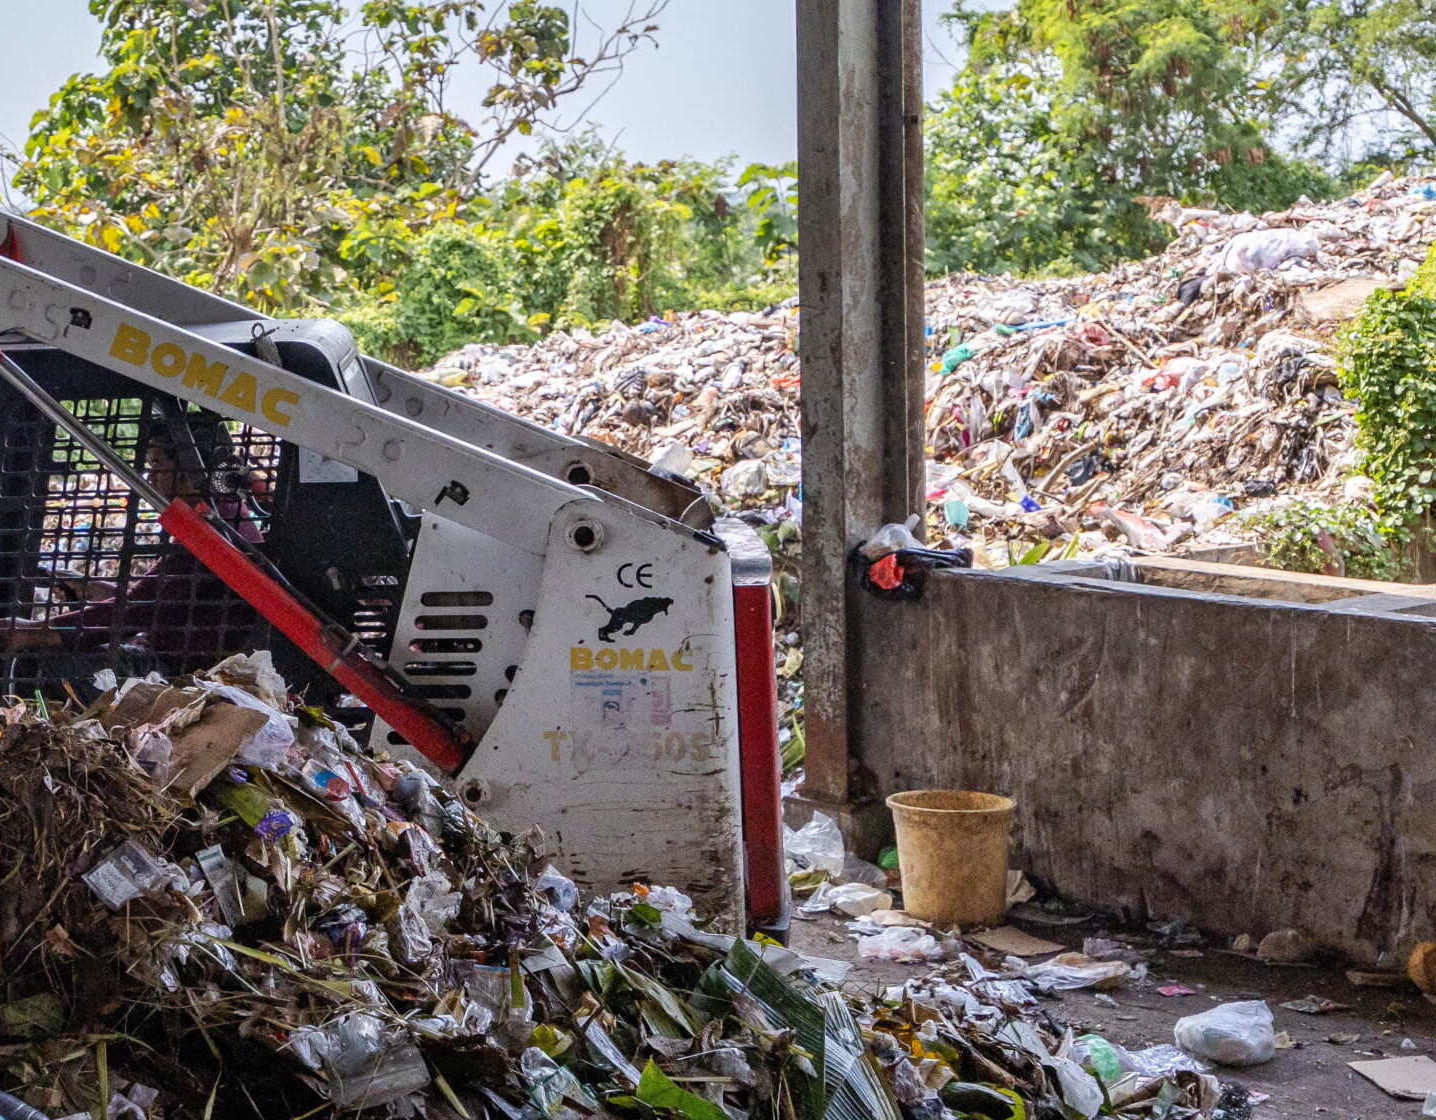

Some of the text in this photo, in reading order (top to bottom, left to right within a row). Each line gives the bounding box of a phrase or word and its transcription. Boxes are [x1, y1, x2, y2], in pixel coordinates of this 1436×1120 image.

[109, 322, 300, 427] BOMAC
[616, 563, 653, 588] CE
[570, 647, 693, 672] BOMAC
